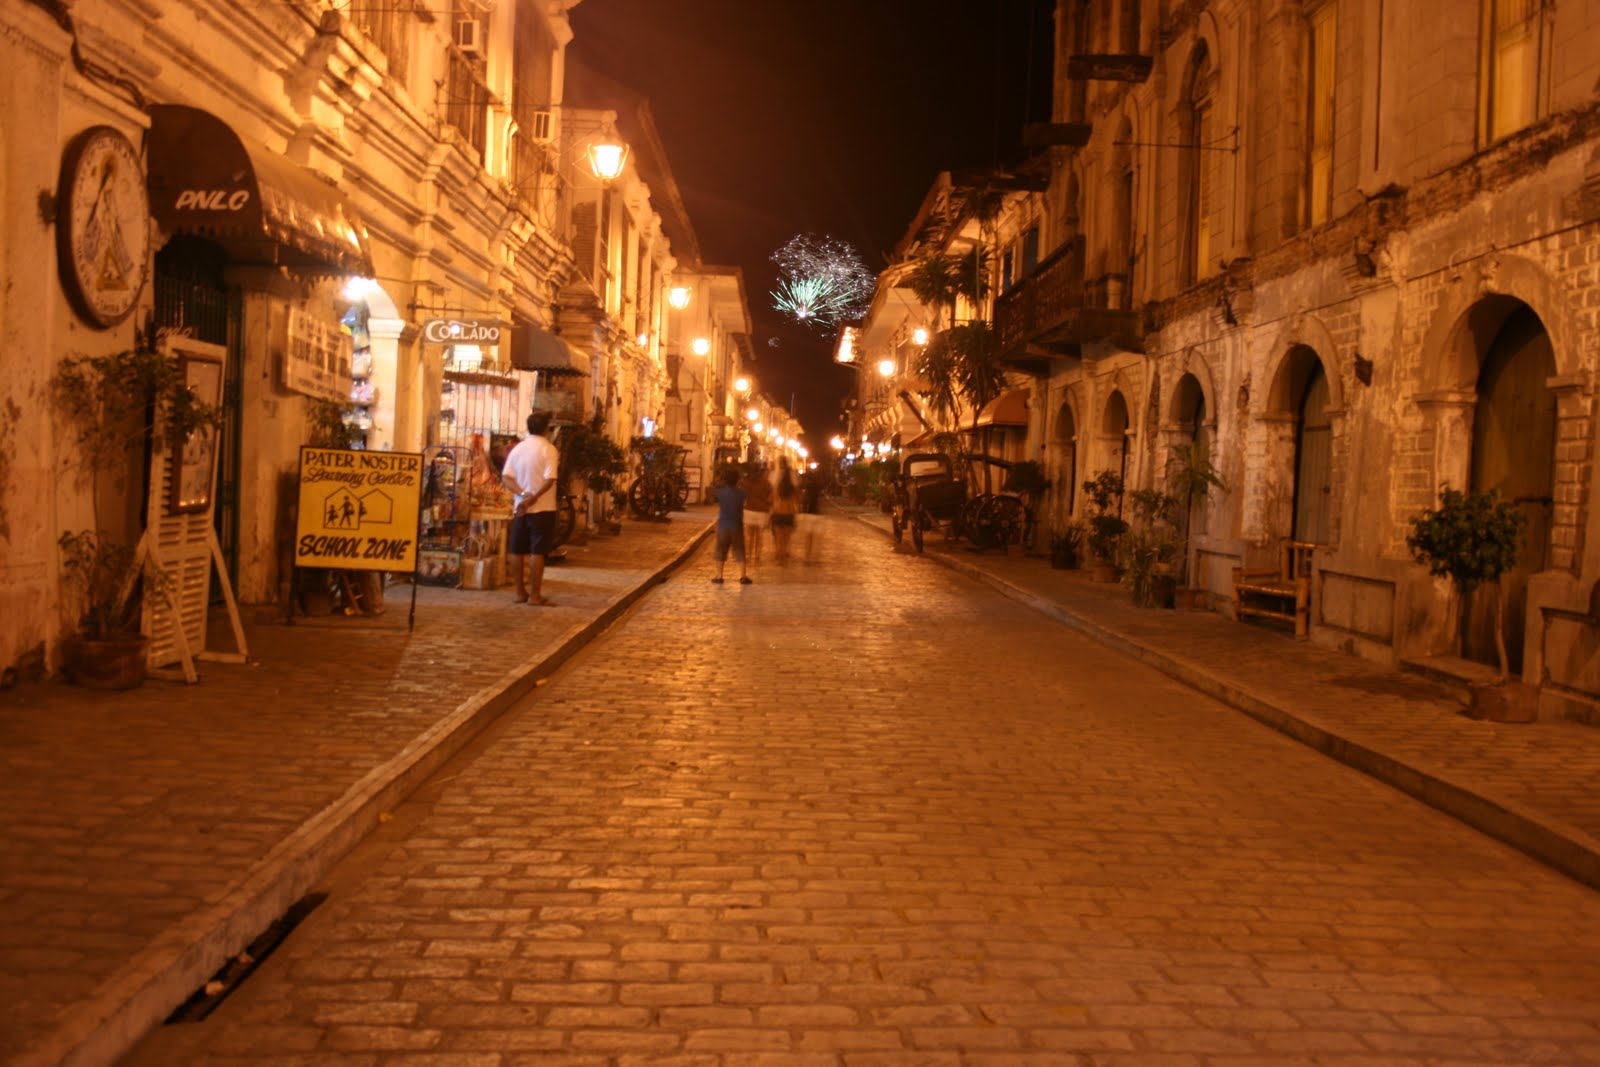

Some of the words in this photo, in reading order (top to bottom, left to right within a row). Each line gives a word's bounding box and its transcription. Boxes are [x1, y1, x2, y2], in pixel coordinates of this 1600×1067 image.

[304, 450, 354, 467] PATER
[359, 455, 418, 472] NOSTER
[303, 467, 366, 487] Learning
[367, 471, 415, 486] Center
[298, 534, 363, 558] SCHOOL
[363, 538, 411, 560] ZONE
